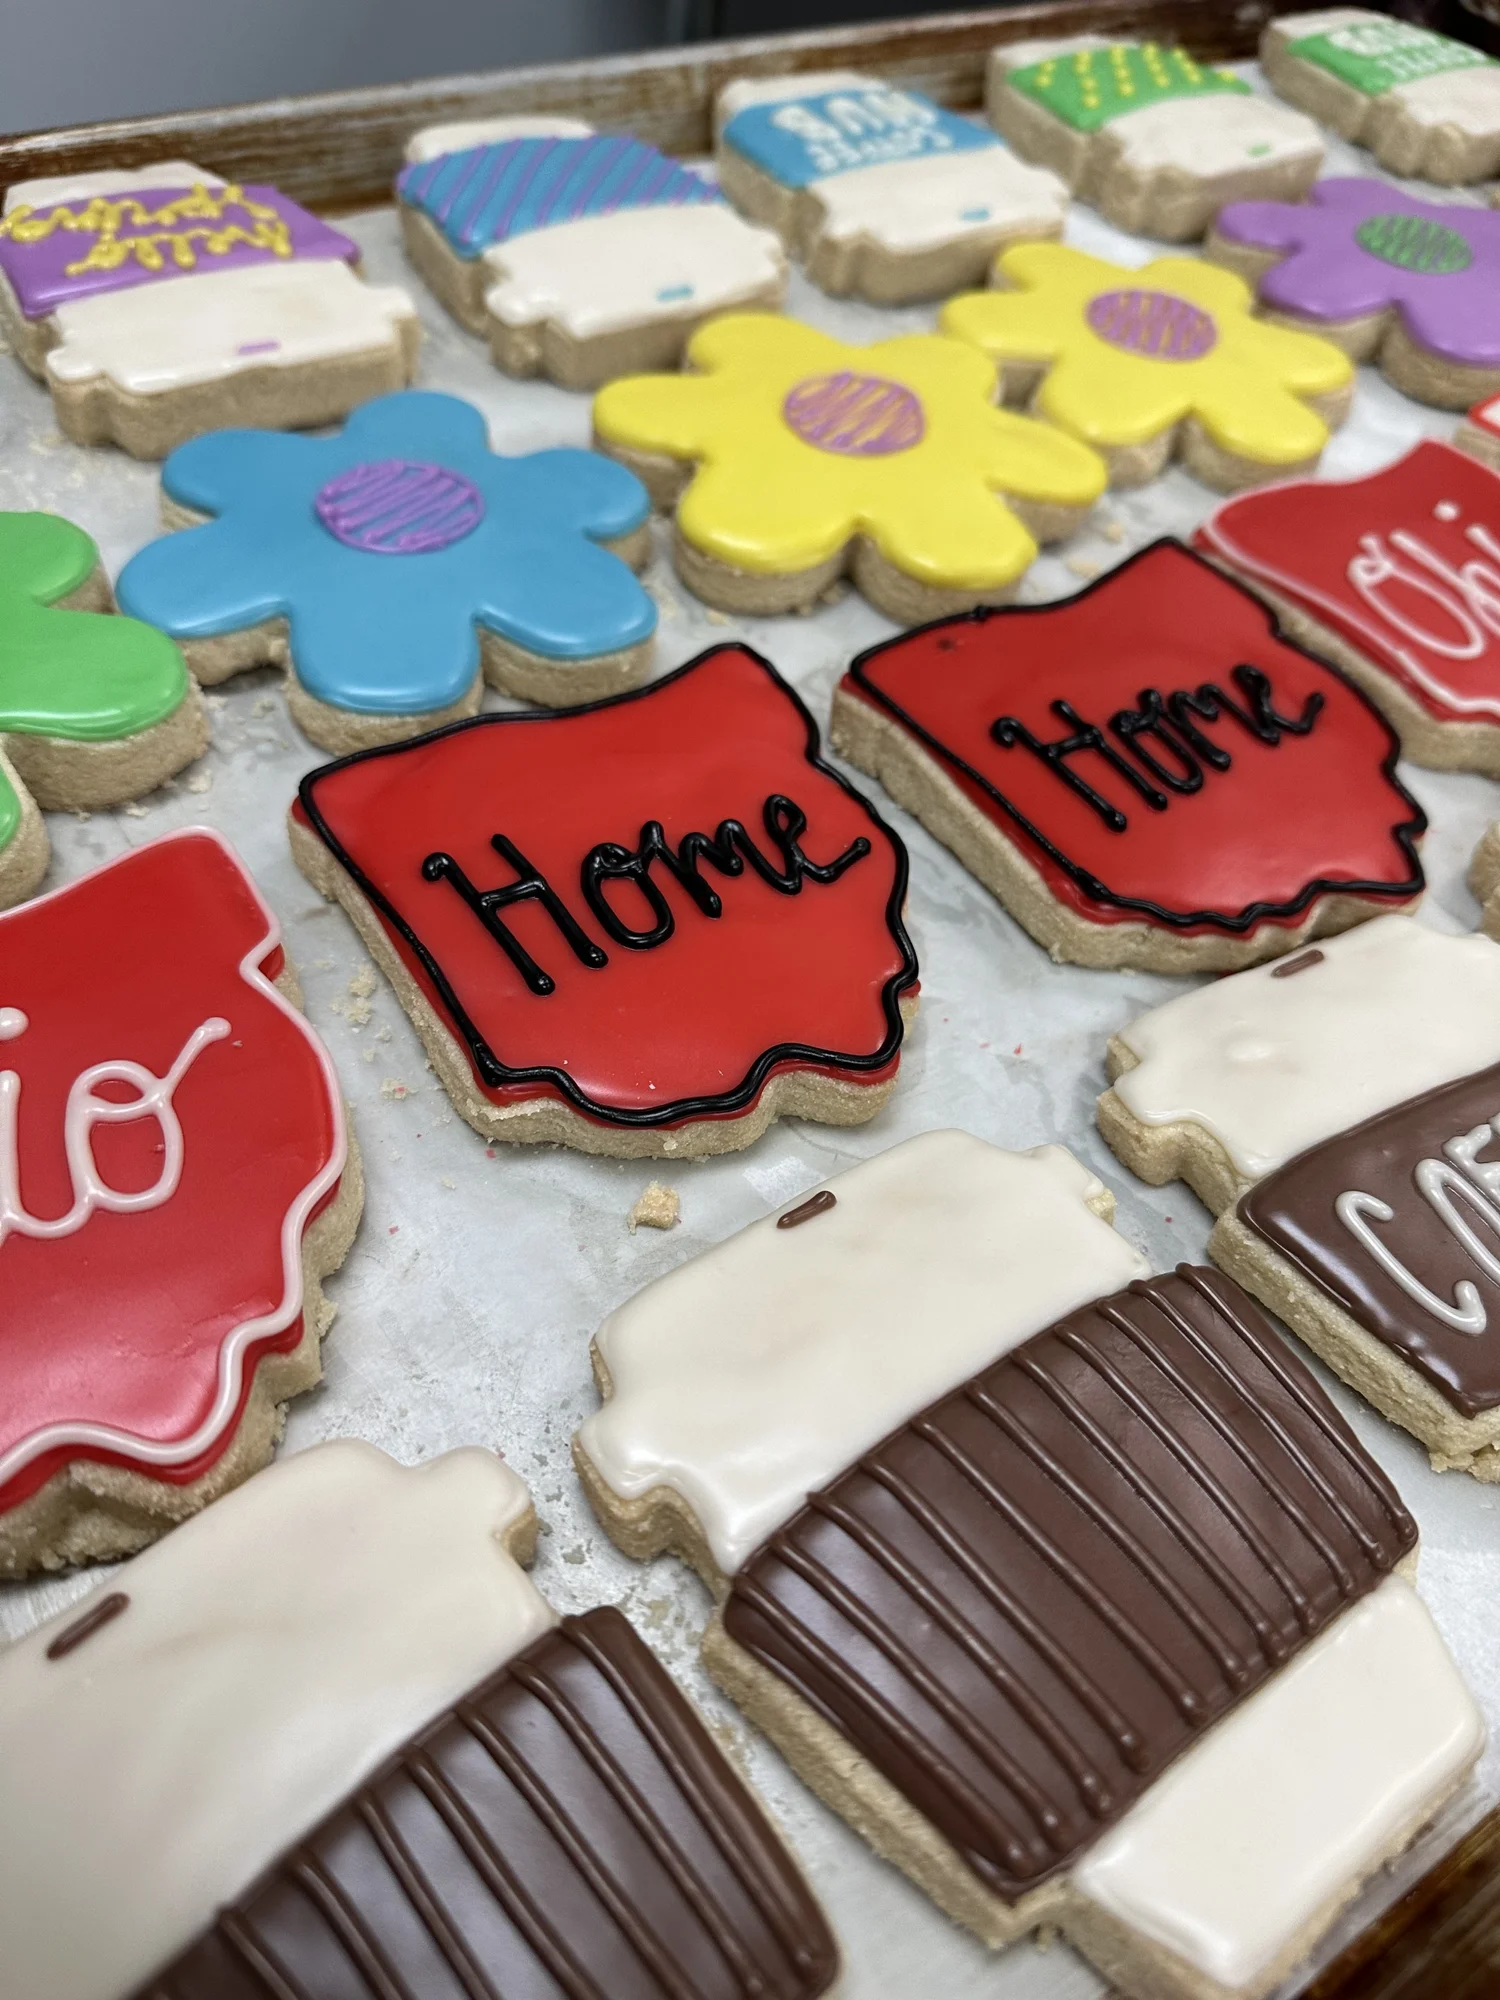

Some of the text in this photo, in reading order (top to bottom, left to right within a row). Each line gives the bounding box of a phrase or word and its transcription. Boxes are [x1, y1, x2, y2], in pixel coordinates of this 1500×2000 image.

[64, 220, 292, 277] hello
[990, 664, 1325, 833] Home
[421, 794, 872, 996] Home
